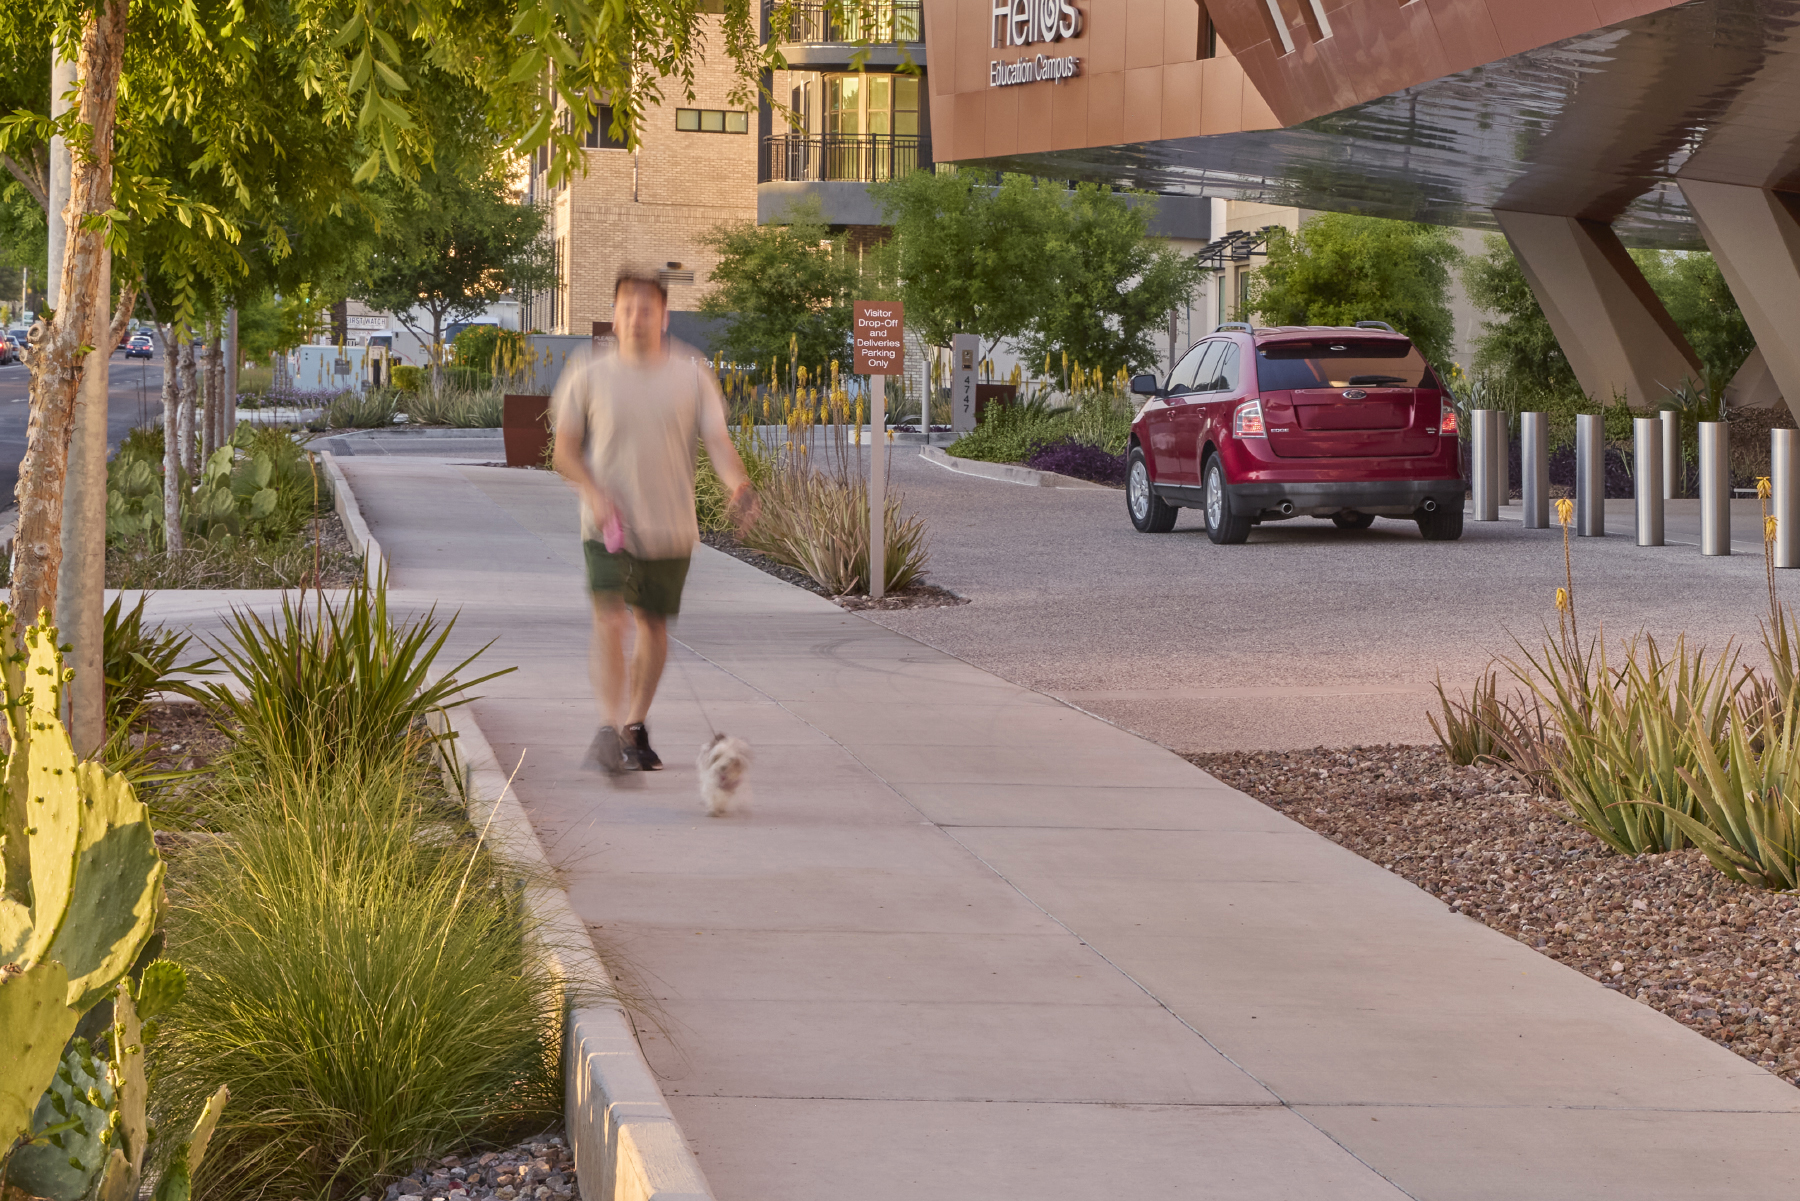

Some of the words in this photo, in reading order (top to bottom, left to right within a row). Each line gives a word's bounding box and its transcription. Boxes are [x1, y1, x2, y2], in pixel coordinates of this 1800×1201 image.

[990, 59, 1033, 87] Education
[1035, 53, 1074, 85] Campus
[864, 308, 892, 317] Visitor
[365, 317, 386, 325] WATCH
[858, 319, 898, 328] Drop-Off
[869, 329, 887, 337] and
[857, 339, 900, 347] Deliveries
[861, 349, 895, 359] Parking
[868, 359, 889, 368] Only
